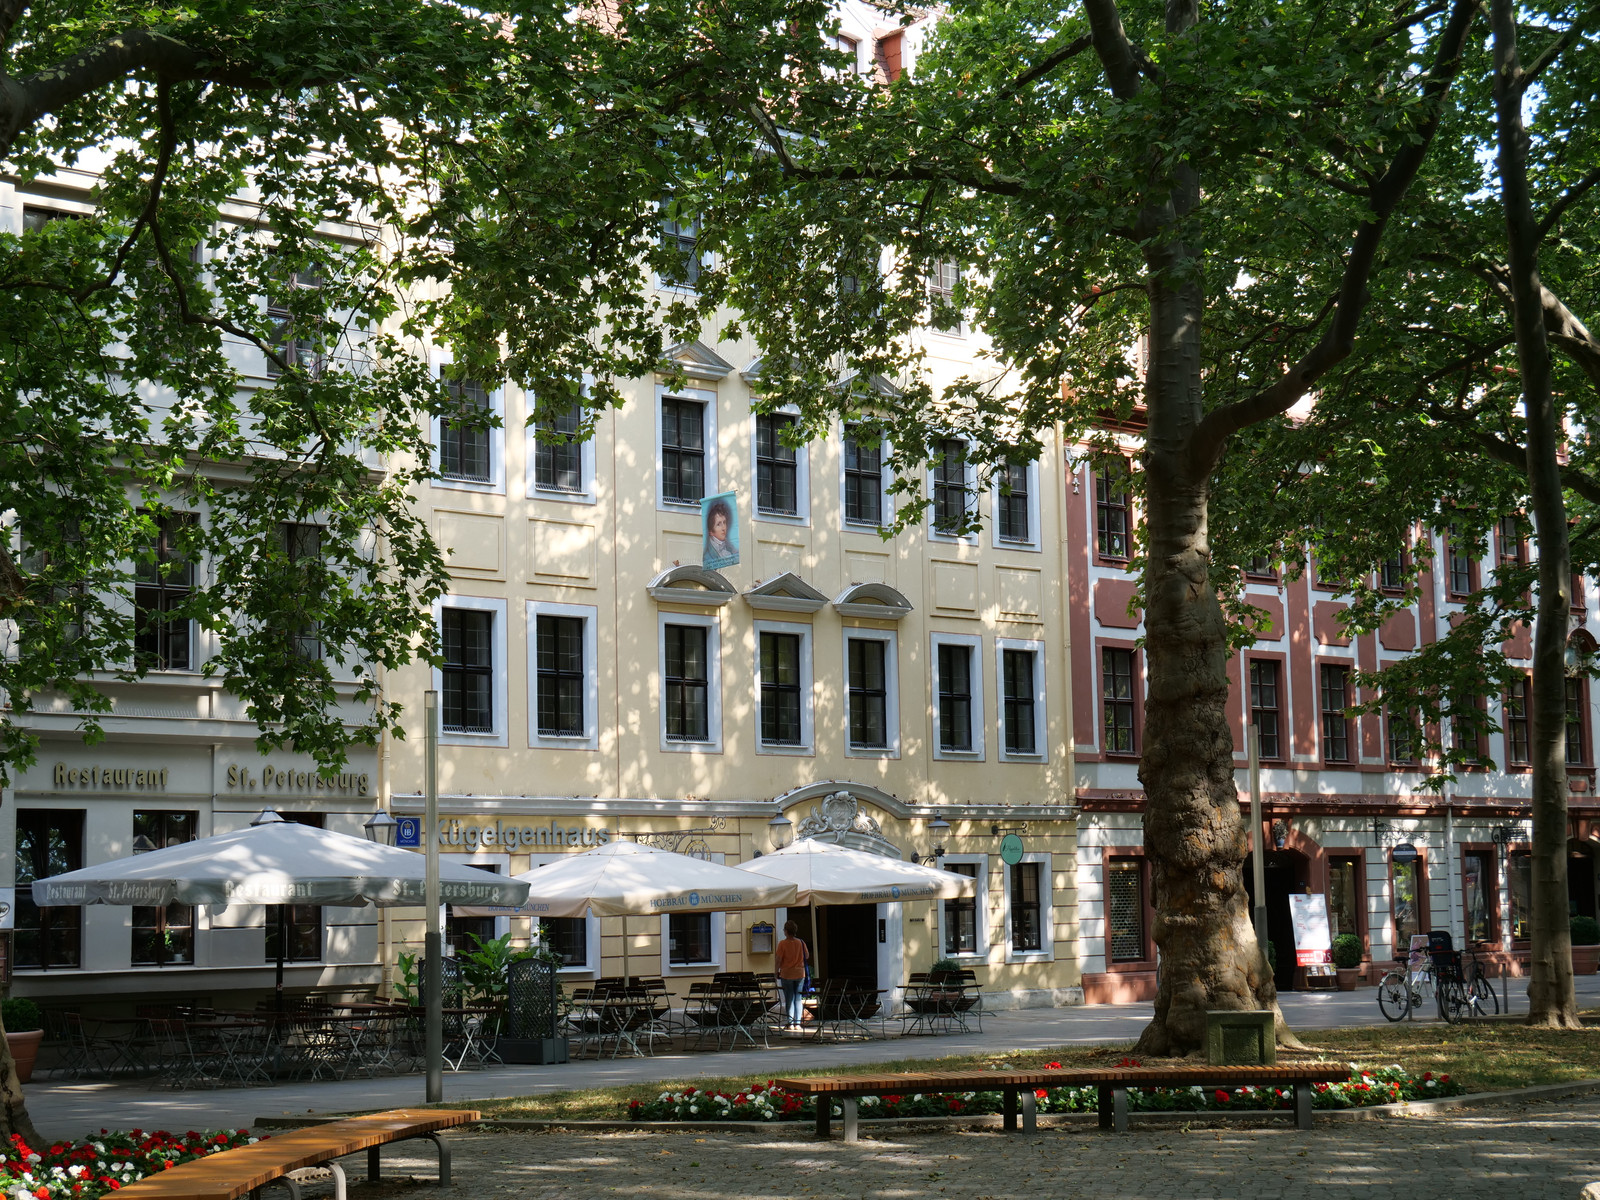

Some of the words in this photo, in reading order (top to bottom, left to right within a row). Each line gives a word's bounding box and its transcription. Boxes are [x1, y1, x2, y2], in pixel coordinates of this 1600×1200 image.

[54, 762, 169, 786] Restaurant
[228, 764, 257, 787] St.
[46, 884, 87, 900] Restaurant
[225, 880, 313, 898] Restaurant
[392, 879, 415, 896] St.
[420, 880, 500, 903] Ptersburg
[650, 894, 687, 908] HOFBRÄU
[700, 893, 742, 904] MÜNCHEN
